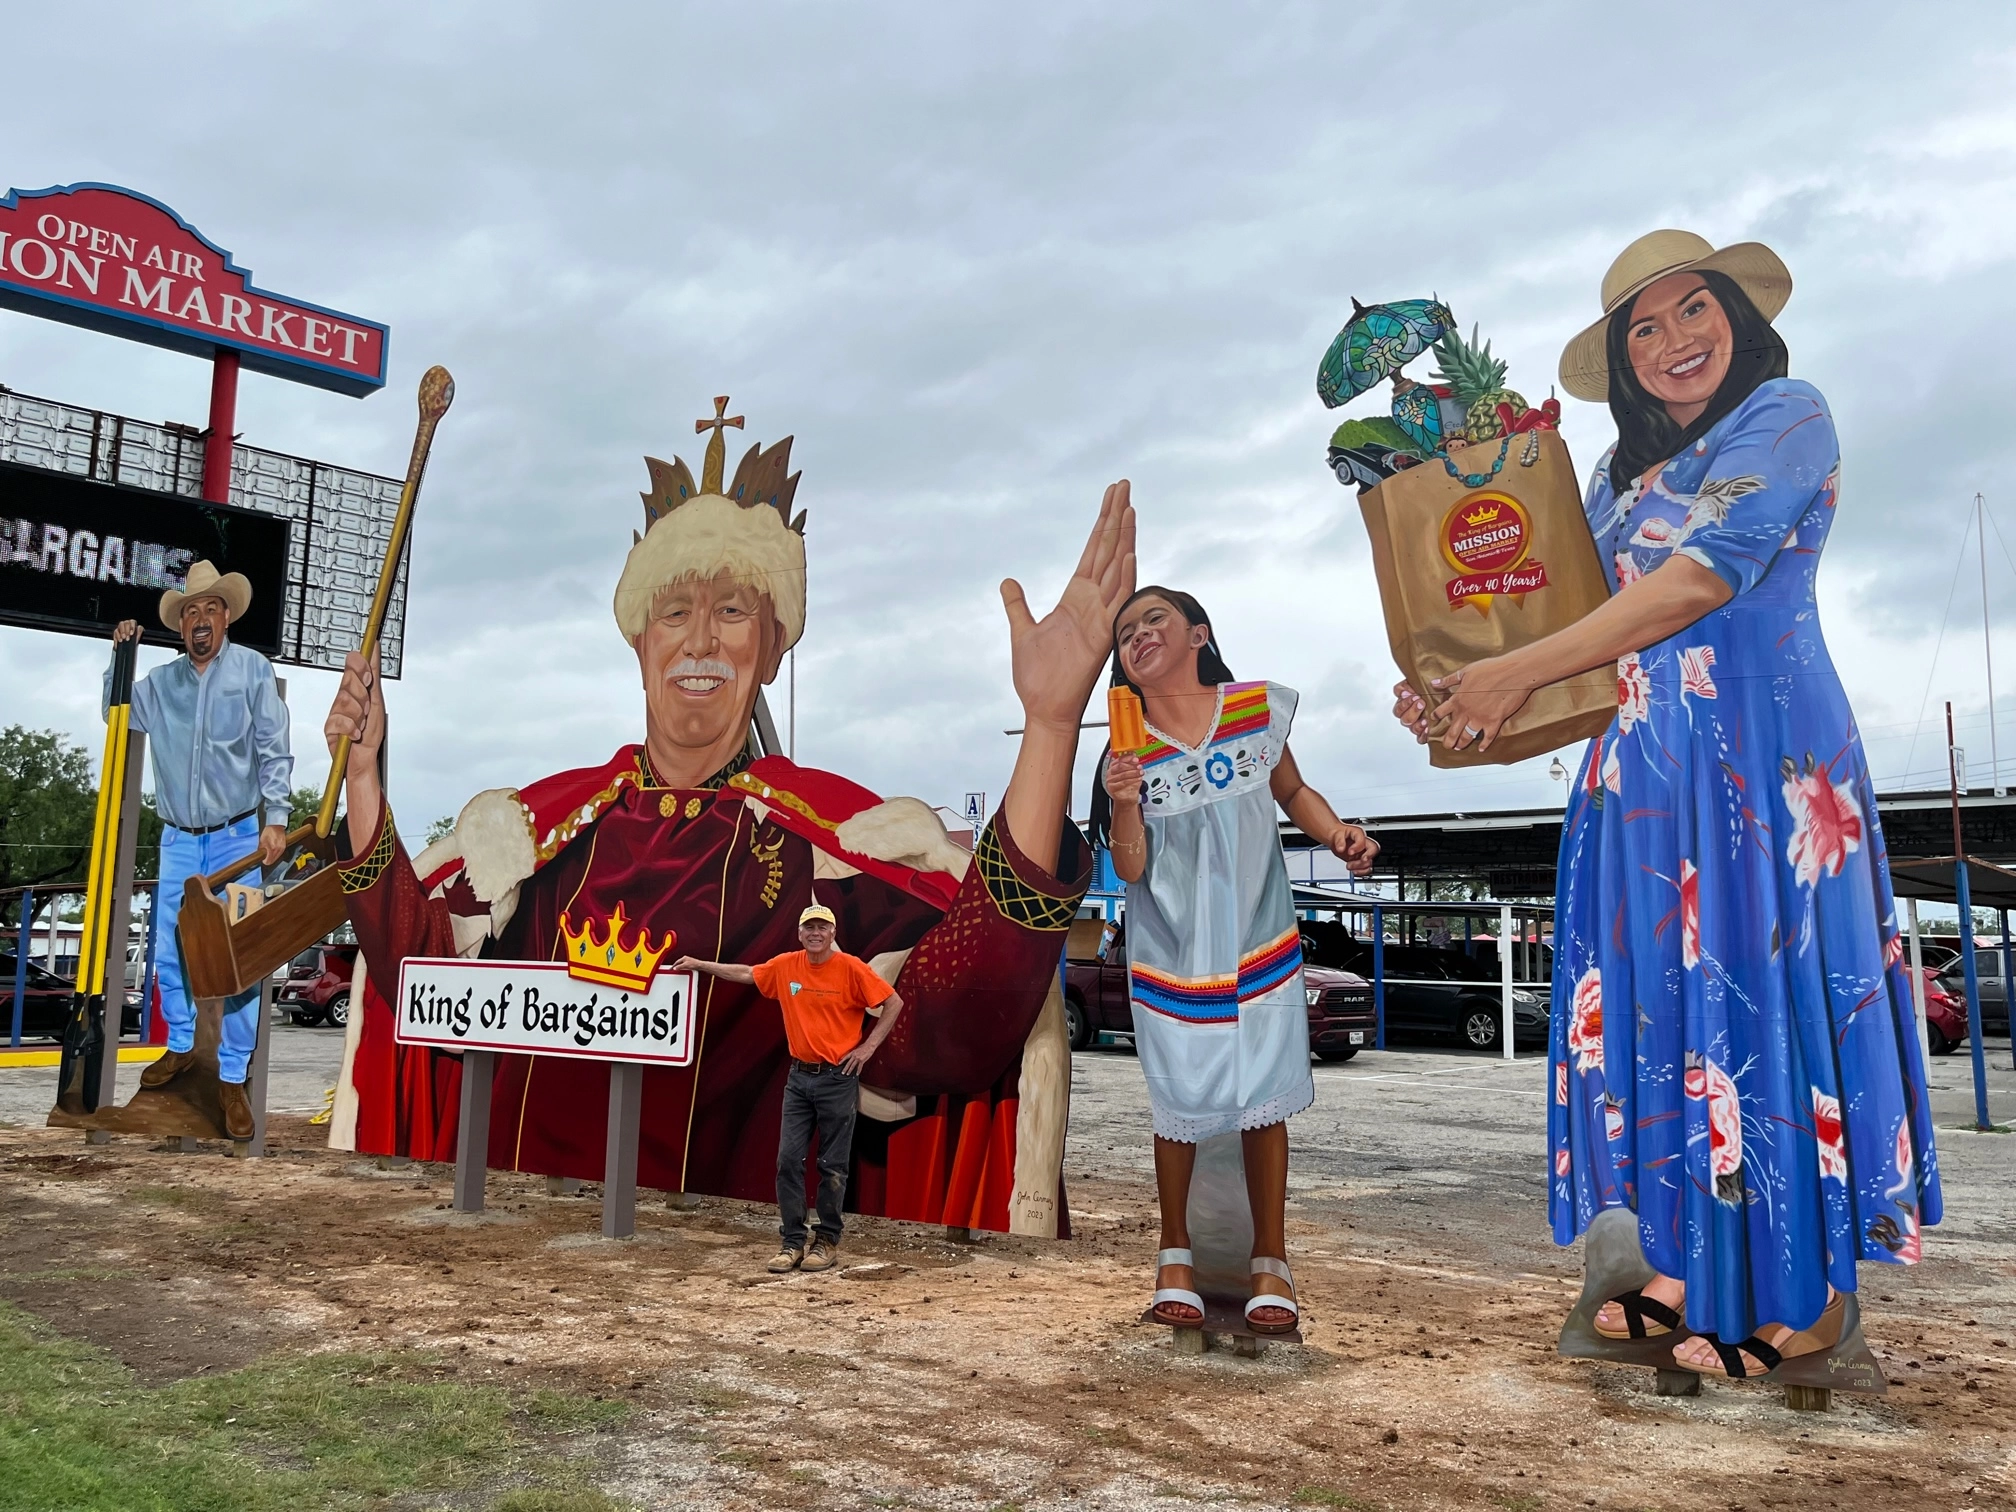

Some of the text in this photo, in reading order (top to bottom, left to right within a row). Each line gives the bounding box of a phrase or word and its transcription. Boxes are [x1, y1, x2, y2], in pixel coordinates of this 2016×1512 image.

[37, 214, 206, 282] OPEN AIR
[118, 266, 368, 365] MARKET
[1453, 524, 1520, 553] MISSION
[1459, 537, 1518, 557] OPEN AIR MARKET
[1453, 569, 1542, 596] Over 40 Years!
[967, 795, 978, 815] A
[408, 982, 681, 1047] King of Bargains!
[1027, 1209, 1044, 1220] 2023
[1827, 1357, 1847, 1373] John
[1853, 1378, 1872, 1387] 2023
